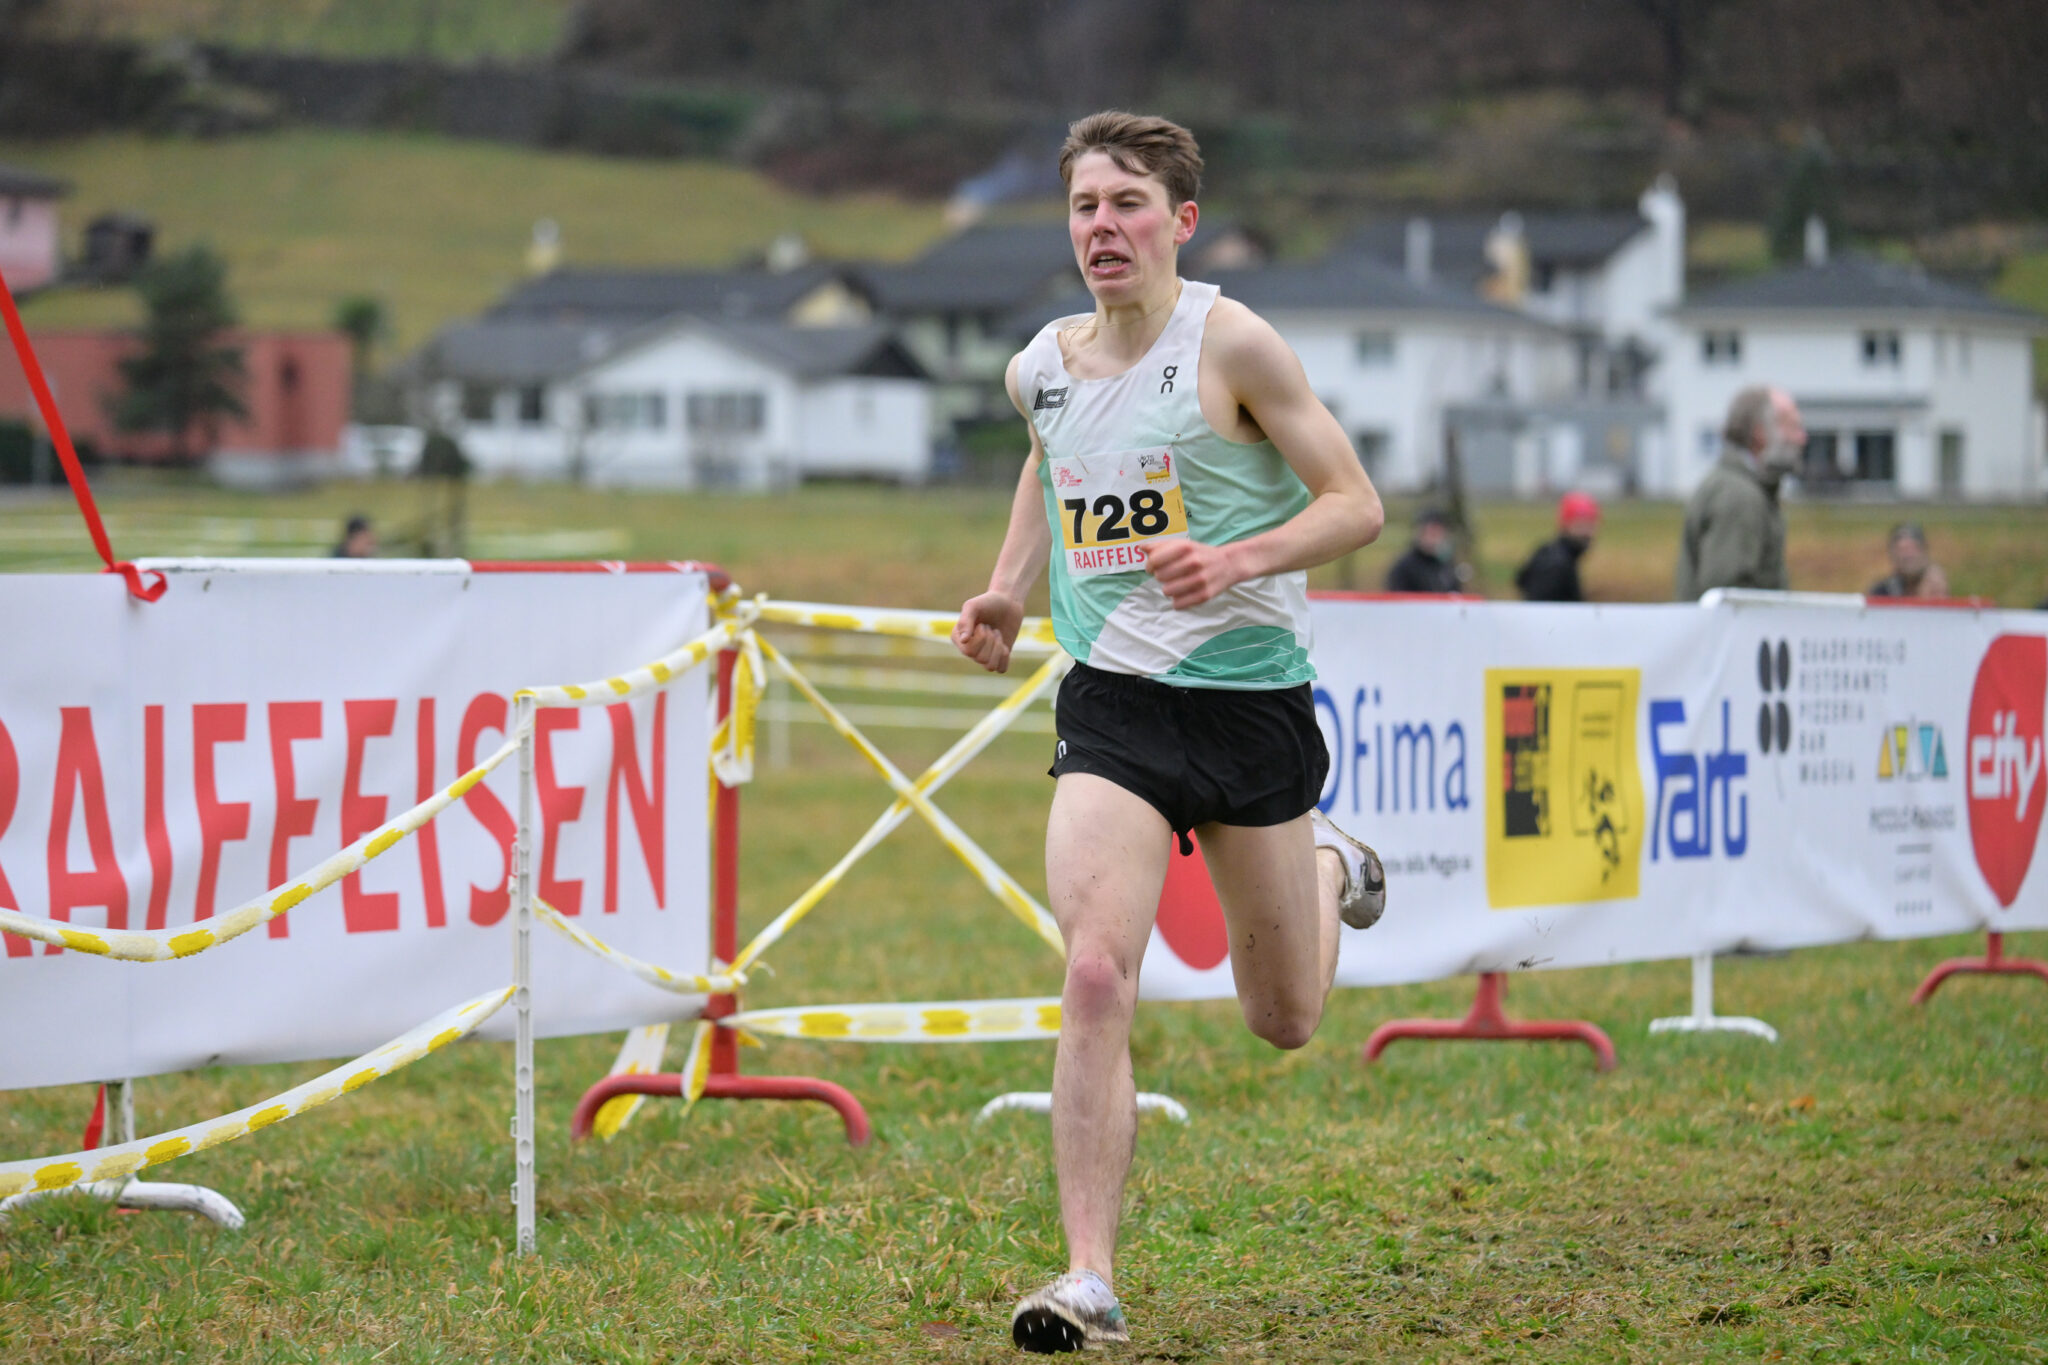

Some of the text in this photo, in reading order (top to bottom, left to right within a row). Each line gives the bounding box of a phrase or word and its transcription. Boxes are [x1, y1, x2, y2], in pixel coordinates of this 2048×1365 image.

[1064, 489, 1169, 544] 728
[1648, 699, 1748, 862] Fart
[1970, 710, 2042, 822] city
